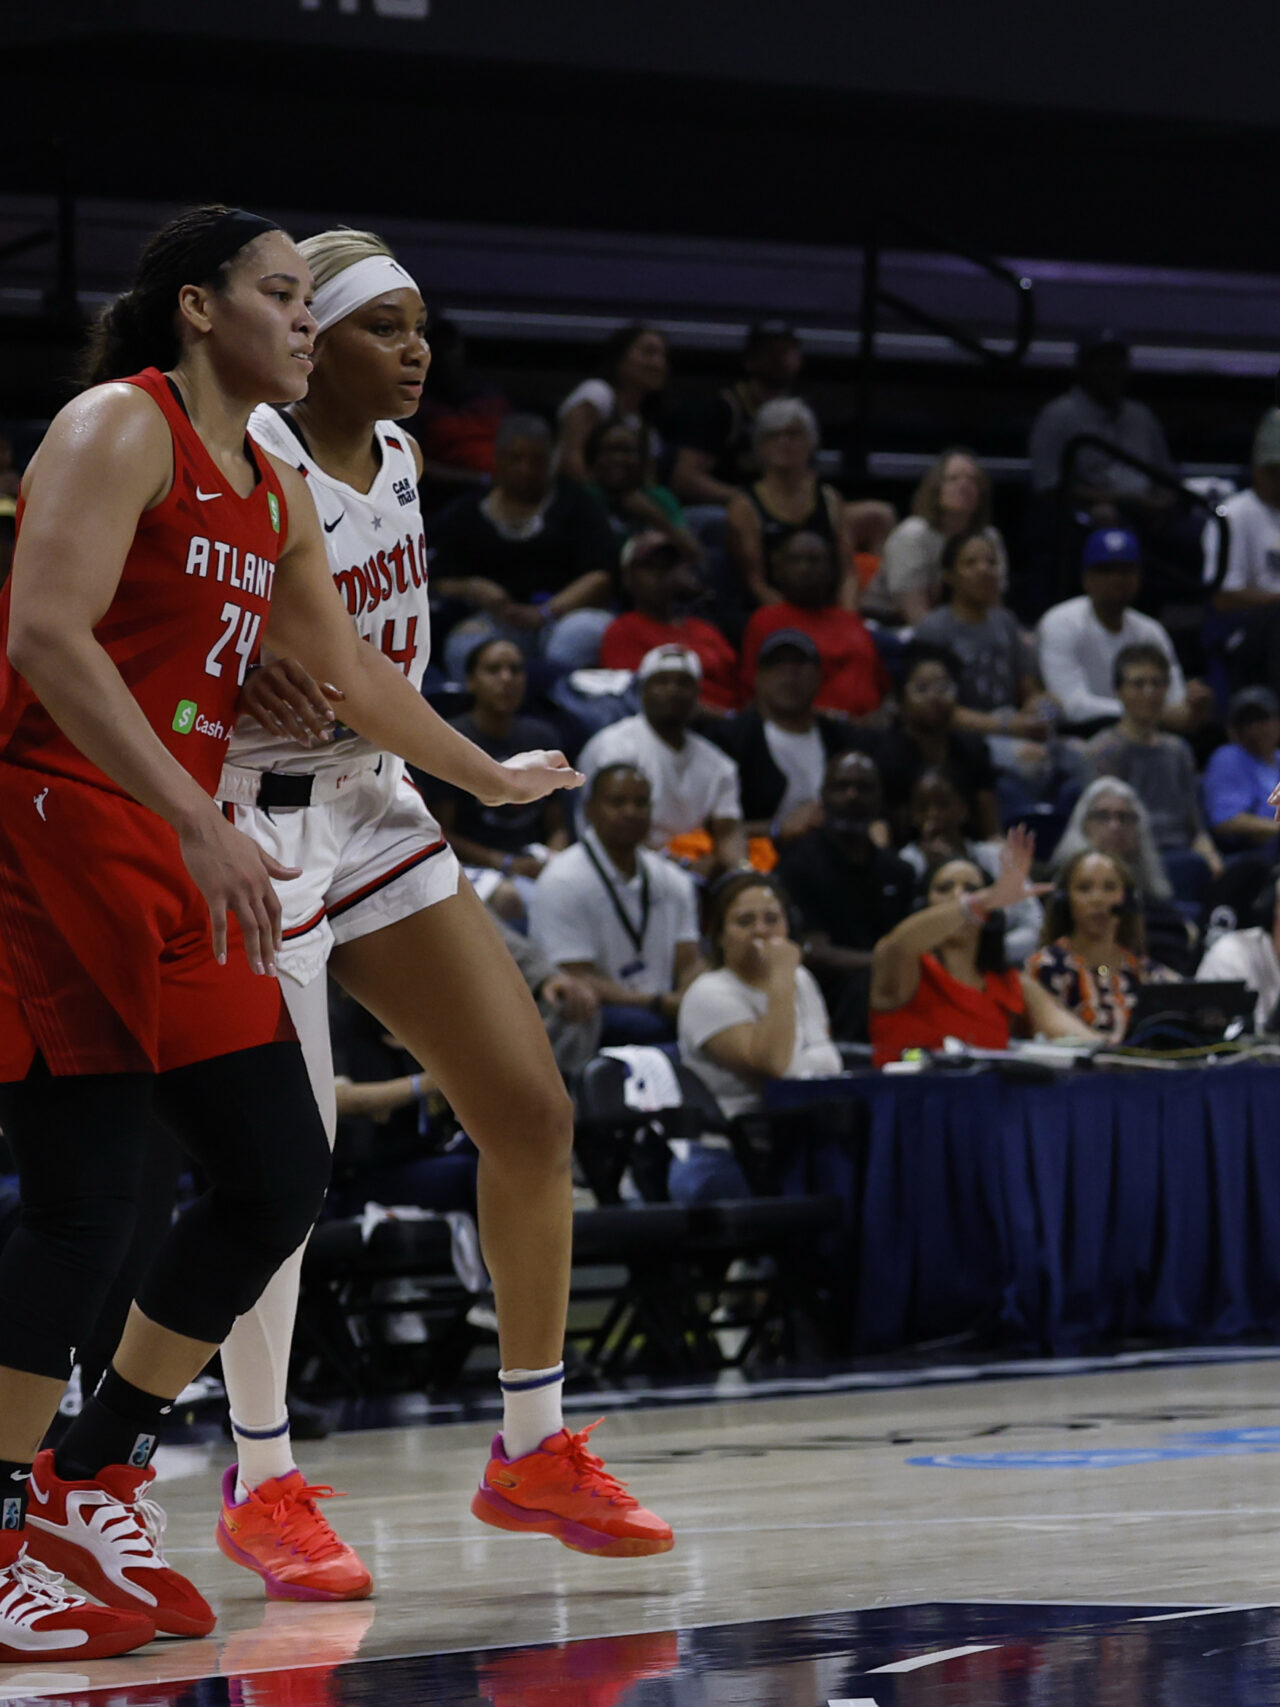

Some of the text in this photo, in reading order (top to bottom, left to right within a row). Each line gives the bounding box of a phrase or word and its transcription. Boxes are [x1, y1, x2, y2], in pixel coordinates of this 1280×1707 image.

[392, 477, 411, 494] CAR
[204, 601, 263, 688] 24
[362, 616, 418, 678] 4
[195, 714, 224, 739] Cash
